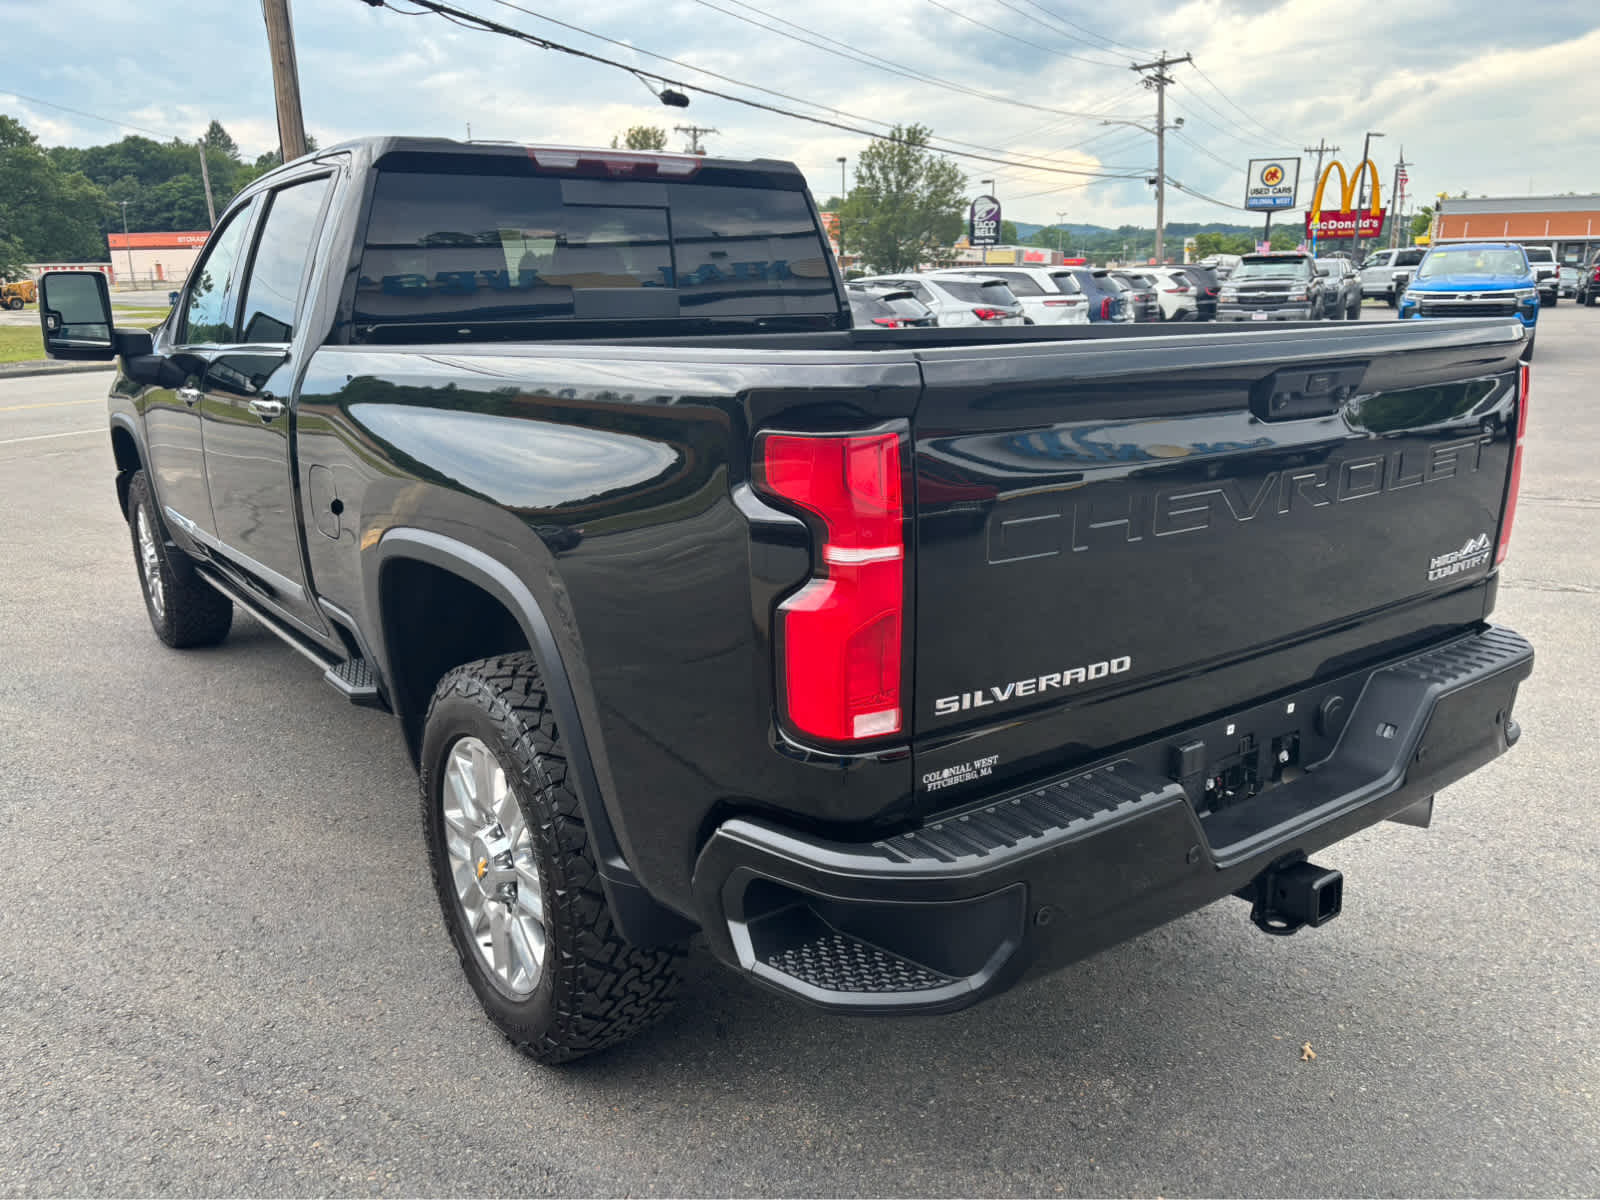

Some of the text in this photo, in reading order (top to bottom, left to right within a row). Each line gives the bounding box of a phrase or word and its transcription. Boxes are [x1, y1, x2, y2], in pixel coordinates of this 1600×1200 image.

[1250, 186, 1292, 195] USED CARS
[974, 220, 996, 229] TACO
[974, 228, 996, 237] BELL
[986, 433, 1492, 565] CHEVROLET
[1428, 552, 1489, 581] COUNTRY
[1430, 551, 1464, 570] HIGH
[934, 655, 1132, 716] SILVERADO
[923, 755, 999, 784] COLONIAL WEST
[927, 767, 992, 792] FITCHBURG, MA
